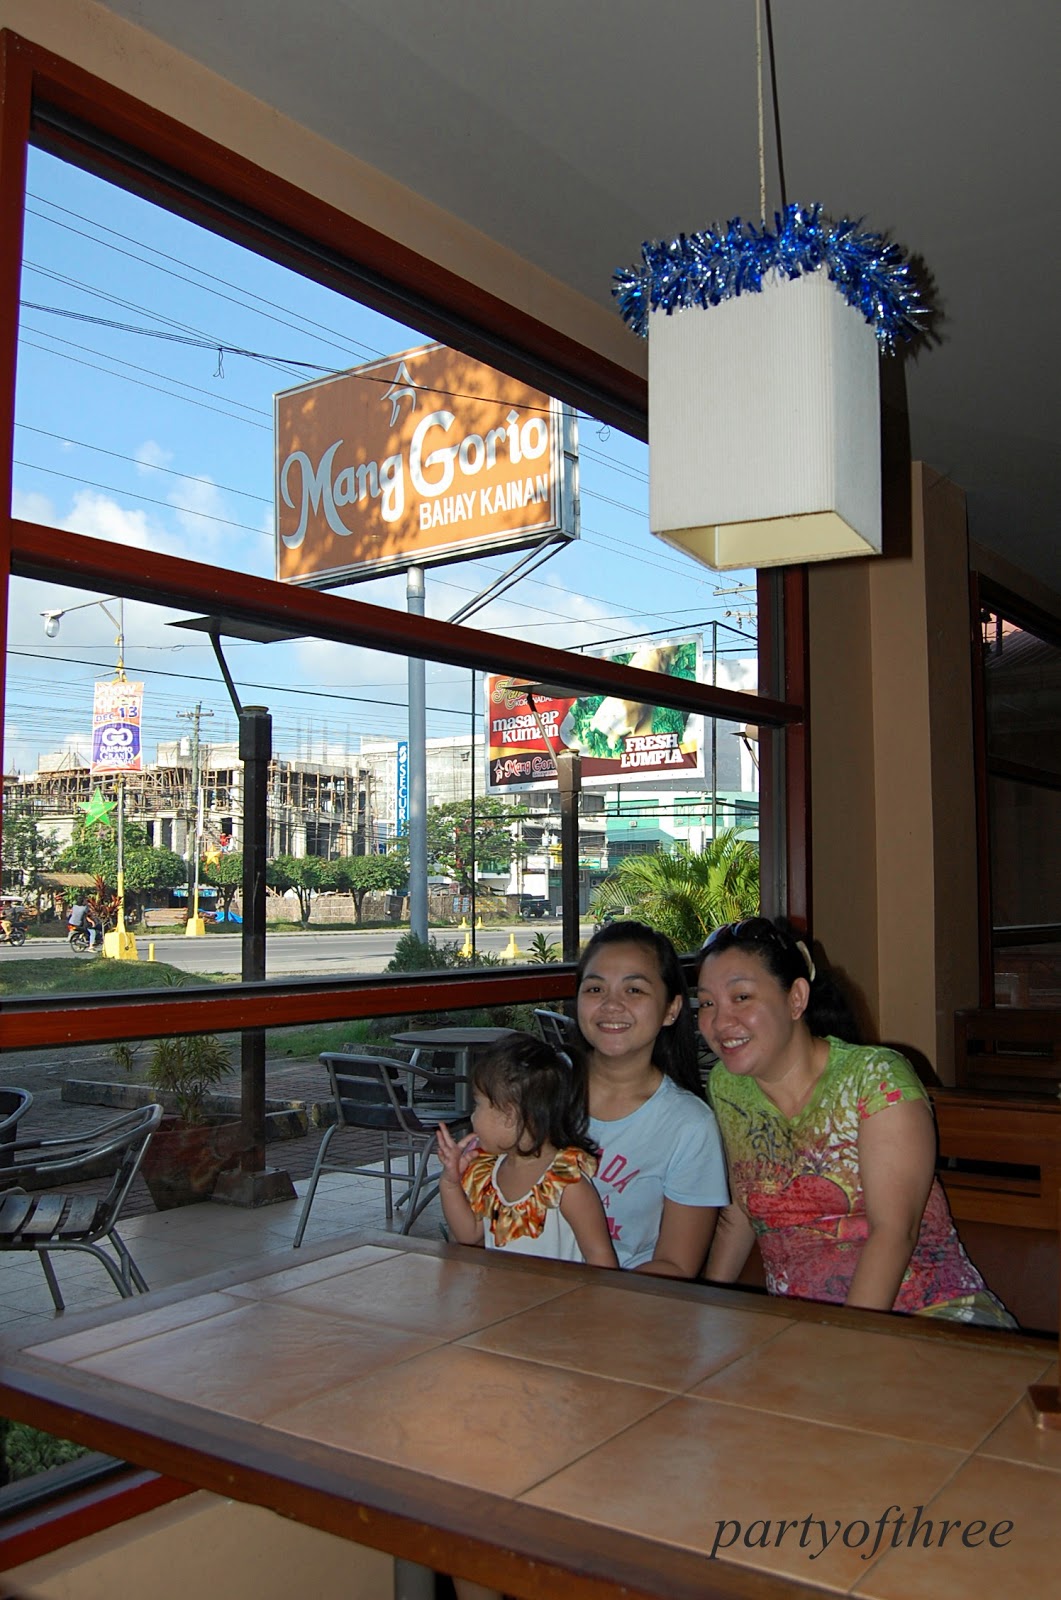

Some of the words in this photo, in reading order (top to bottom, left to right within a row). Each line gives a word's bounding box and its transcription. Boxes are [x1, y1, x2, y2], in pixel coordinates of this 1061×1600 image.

[280, 439, 405, 550] Mang
[409, 408, 549, 498] Gorio
[419, 491, 476, 531] BAHAY
[480, 474, 549, 517] KAINAN
[119, 706, 138, 718] 13
[624, 733, 679, 754] FRESH
[99, 750, 135, 760] GRAND
[620, 749, 684, 768] LUMPIA
[504, 758, 531, 778] Mang
